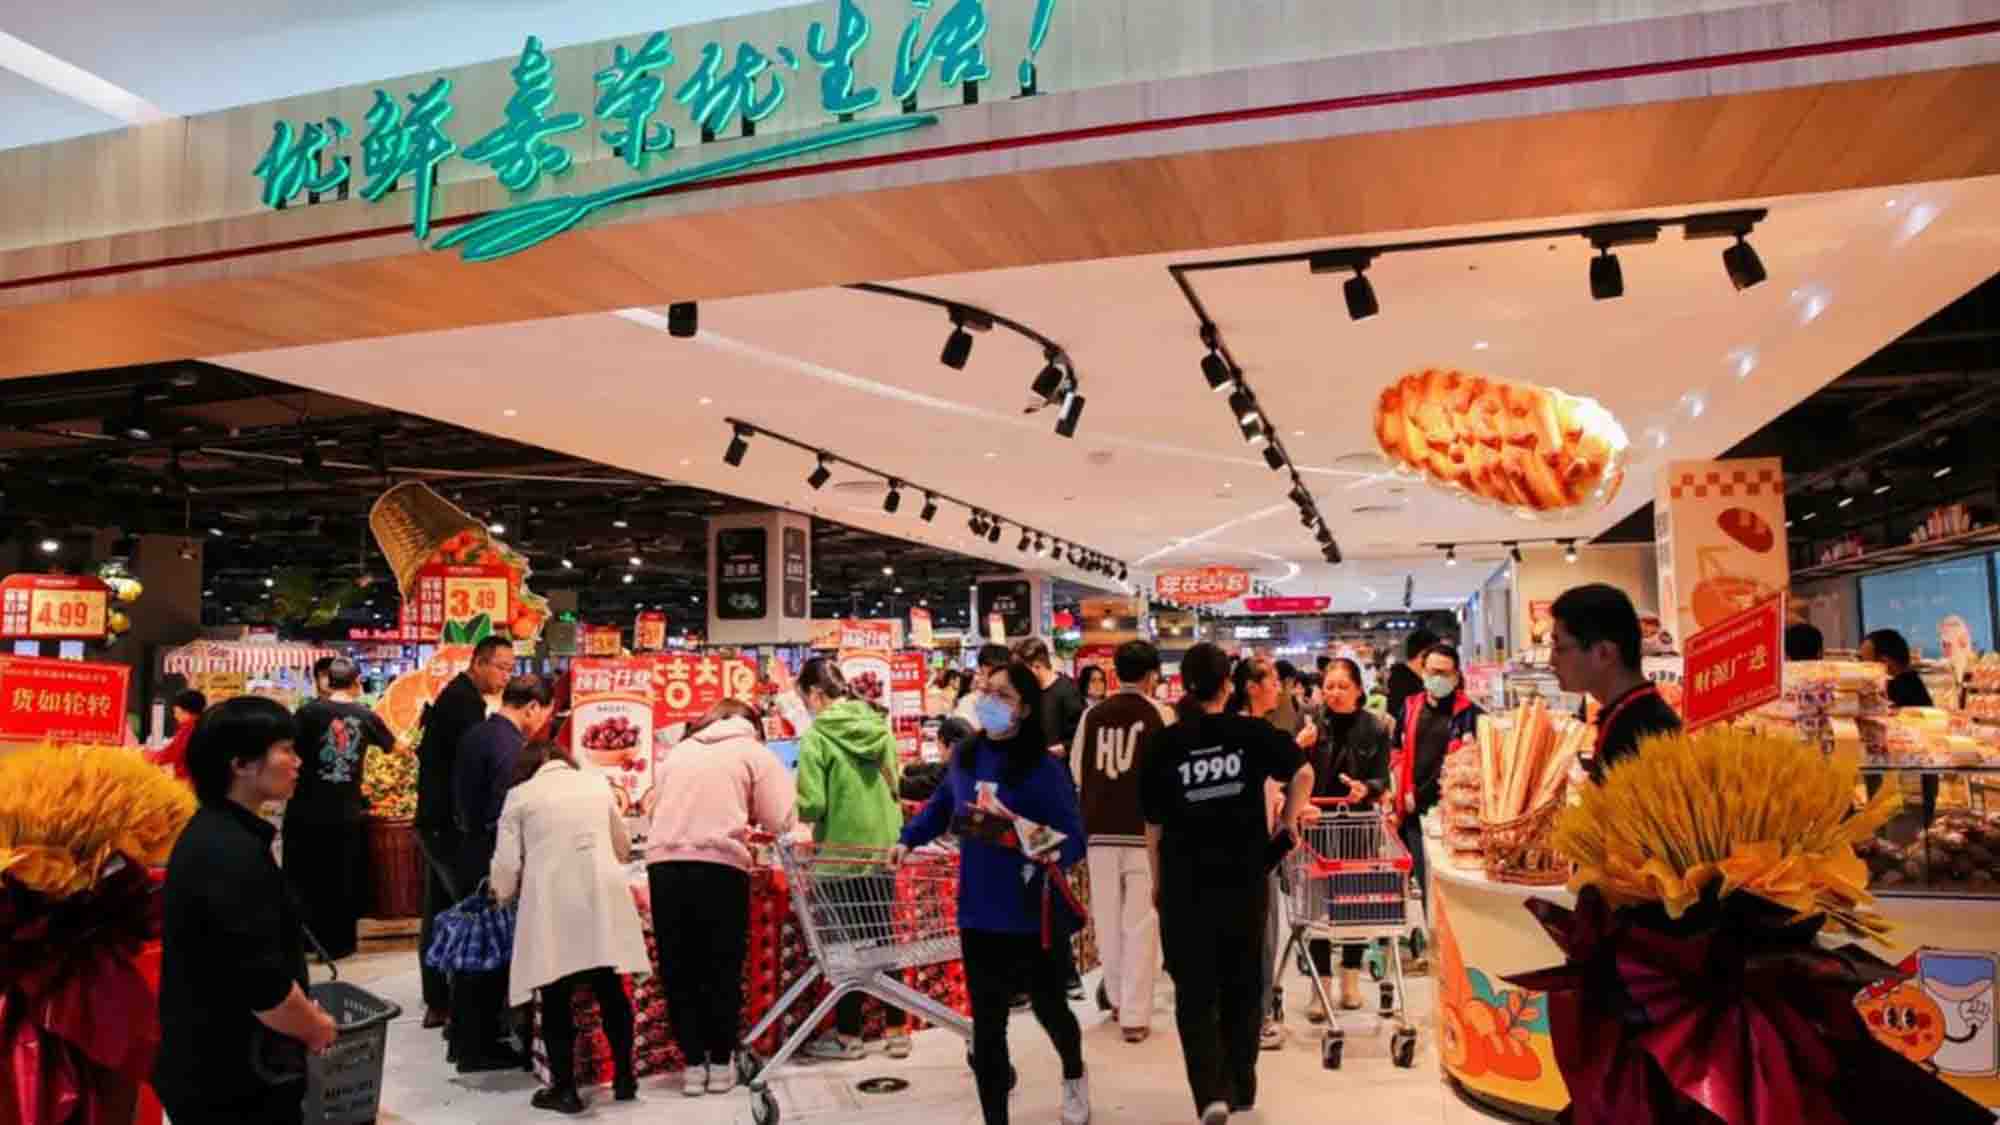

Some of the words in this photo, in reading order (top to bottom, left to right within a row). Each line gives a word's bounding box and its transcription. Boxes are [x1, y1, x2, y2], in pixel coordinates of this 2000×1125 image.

[36, 600, 89, 627] 4.99
[449, 588, 497, 617] 3.49
[9, 686, 112, 718] 货如轮转
[1177, 753, 1241, 786] 1990
